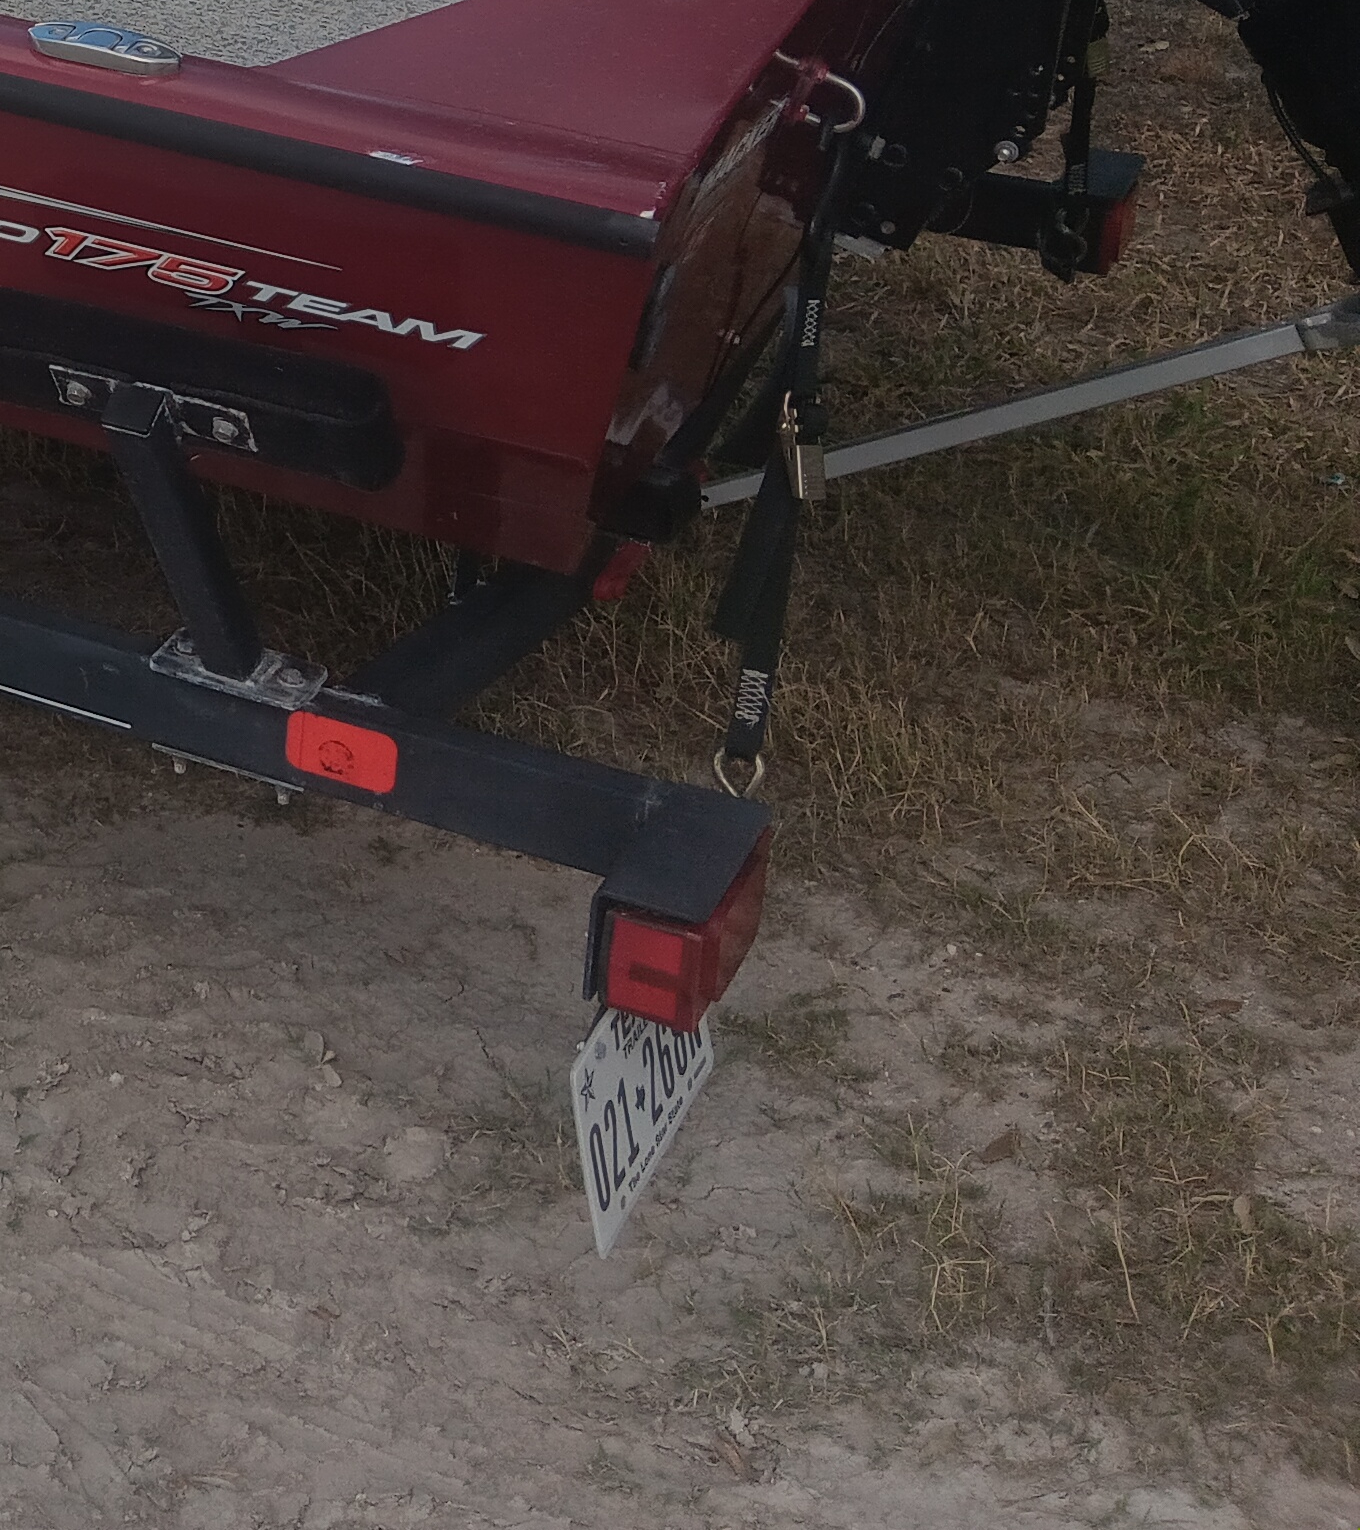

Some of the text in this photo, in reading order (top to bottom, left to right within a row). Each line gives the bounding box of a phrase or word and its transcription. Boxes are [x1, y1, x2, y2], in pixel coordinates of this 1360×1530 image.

[43, 225, 246, 295] 175
[243, 280, 486, 350] TEAM
[589, 1077, 640, 1211] 021
[628, 1171, 641, 1192] The
[640, 1145, 655, 1173] Lone
